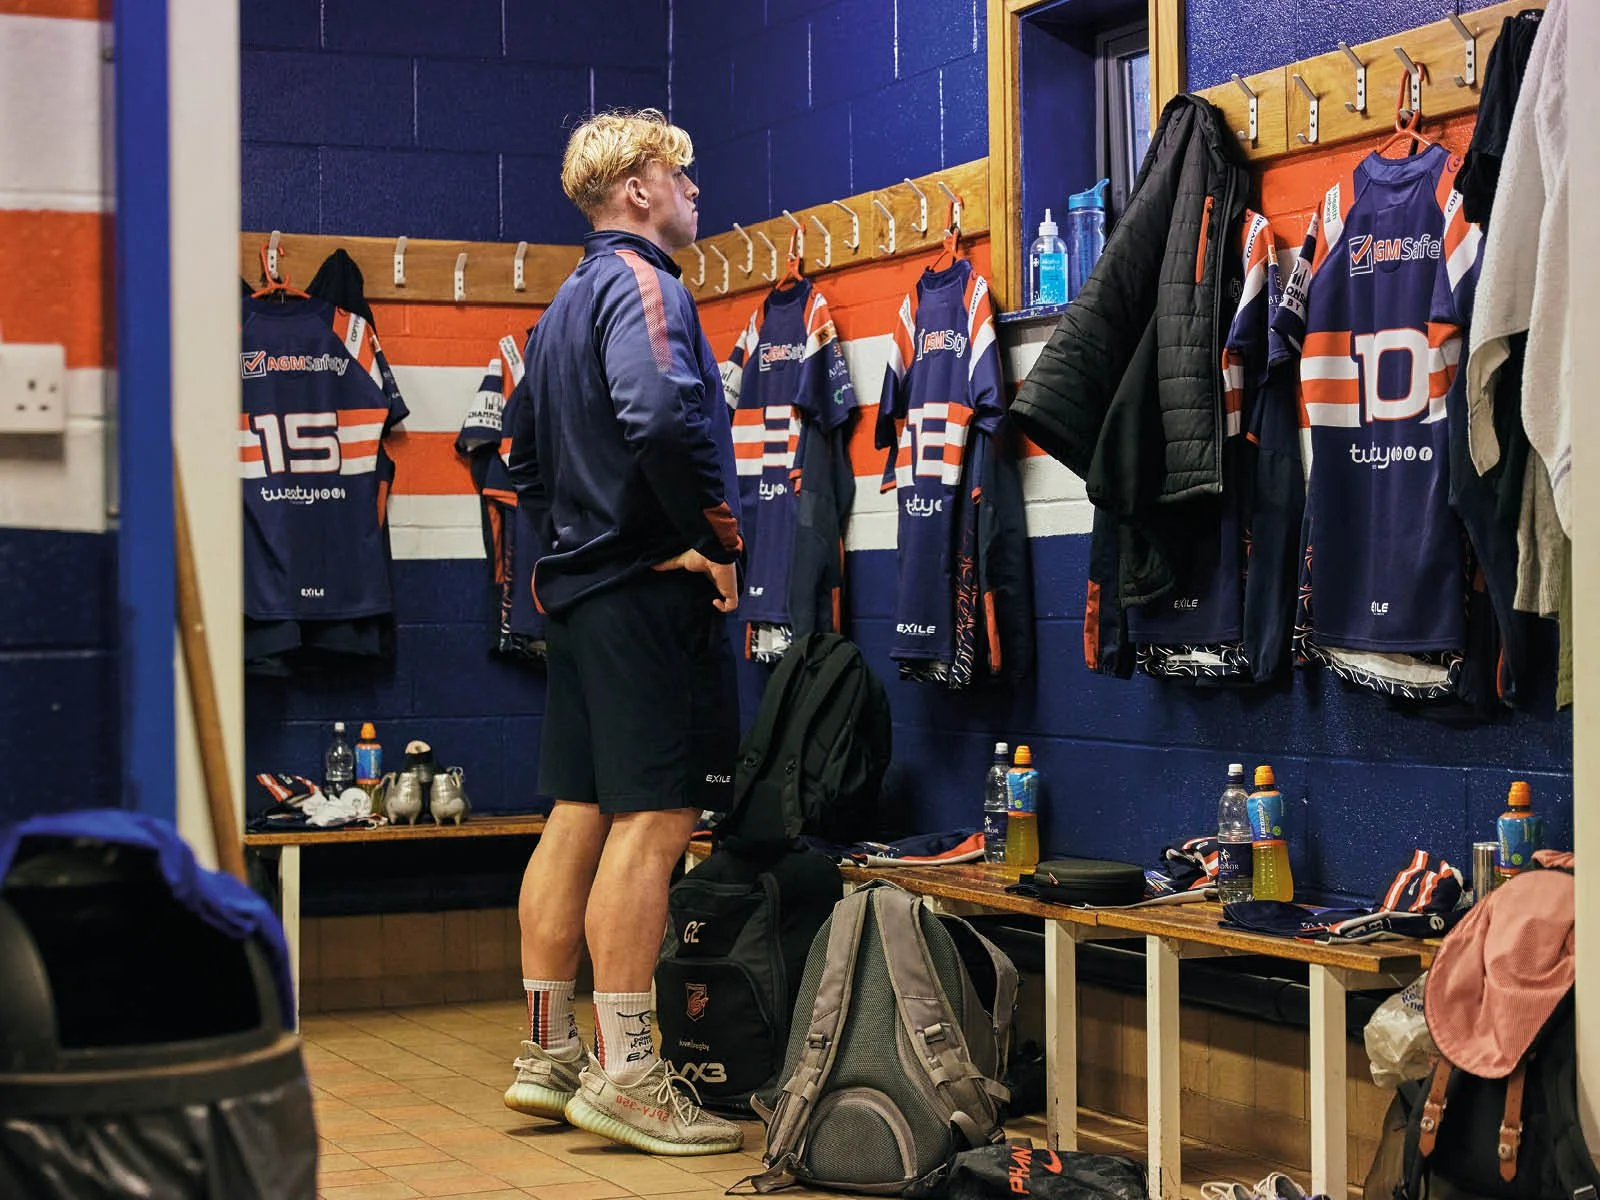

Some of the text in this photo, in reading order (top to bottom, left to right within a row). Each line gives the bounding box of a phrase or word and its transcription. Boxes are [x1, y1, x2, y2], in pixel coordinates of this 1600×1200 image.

[253, 411, 341, 473] 15
[301, 588, 324, 597] EXILE
[1173, 598, 1198, 609] EXILE
[896, 623, 937, 635] EXILE
[705, 774, 731, 783] EXILE
